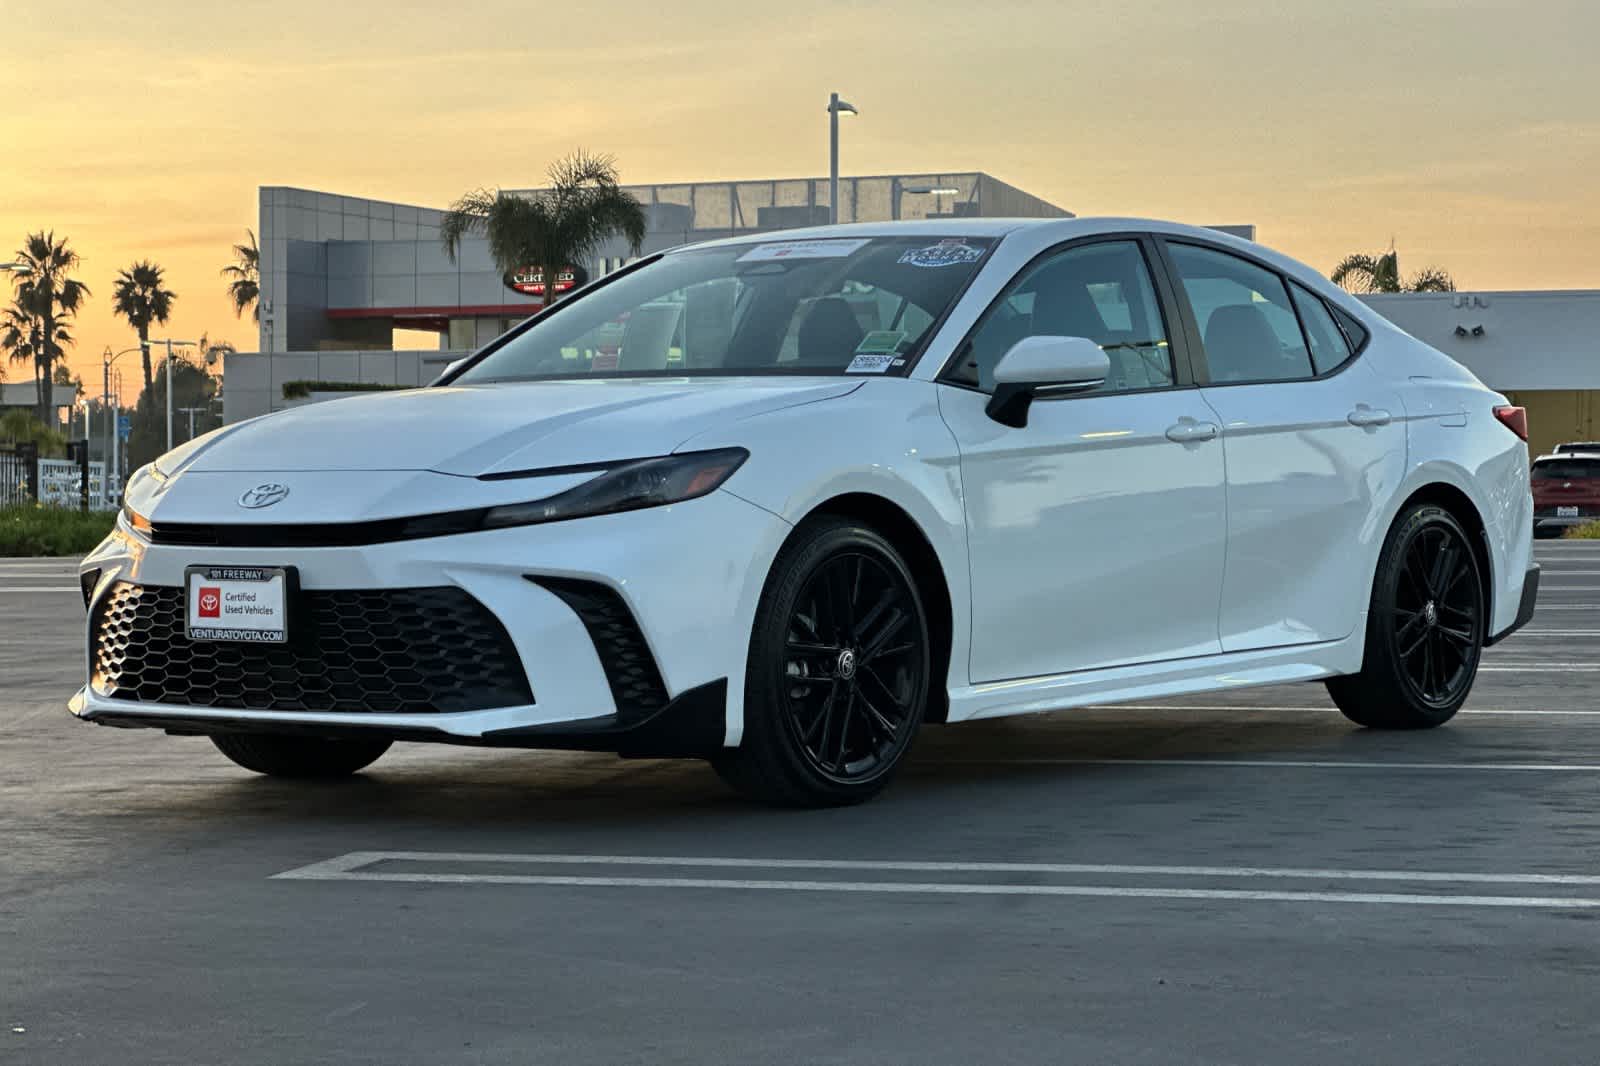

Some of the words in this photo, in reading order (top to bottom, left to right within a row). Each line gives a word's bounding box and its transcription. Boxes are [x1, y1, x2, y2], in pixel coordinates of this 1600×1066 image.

[210, 569, 221, 579] 101
[223, 569, 263, 580] FREEWAY
[225, 592, 257, 602] Certified
[225, 605, 243, 615] Used
[244, 606, 274, 615] Vehicles
[190, 628, 283, 641] VENTURATOYOTA.COM
